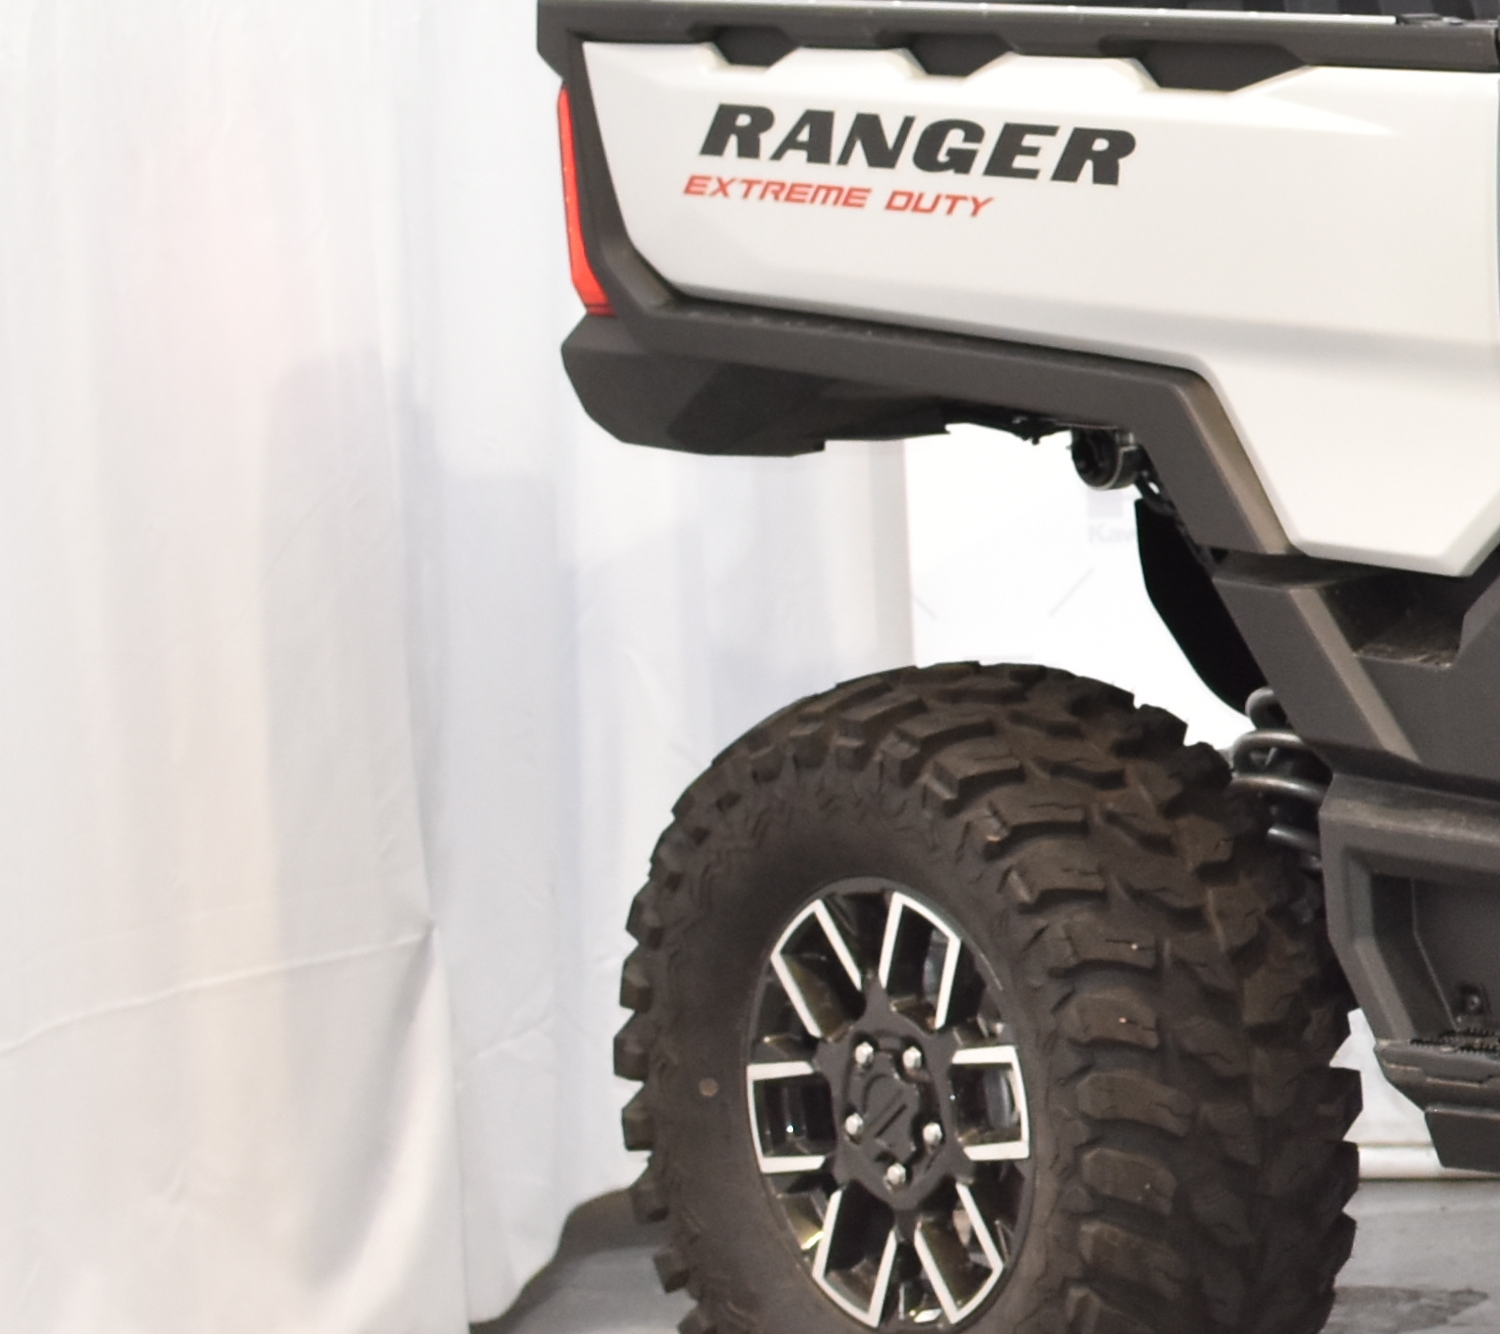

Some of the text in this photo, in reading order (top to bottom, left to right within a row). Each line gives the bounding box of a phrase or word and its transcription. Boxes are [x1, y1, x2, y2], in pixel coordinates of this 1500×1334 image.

[700, 103, 1136, 186] RANGER
[683, 174, 993, 217] EXTREME DUTY
